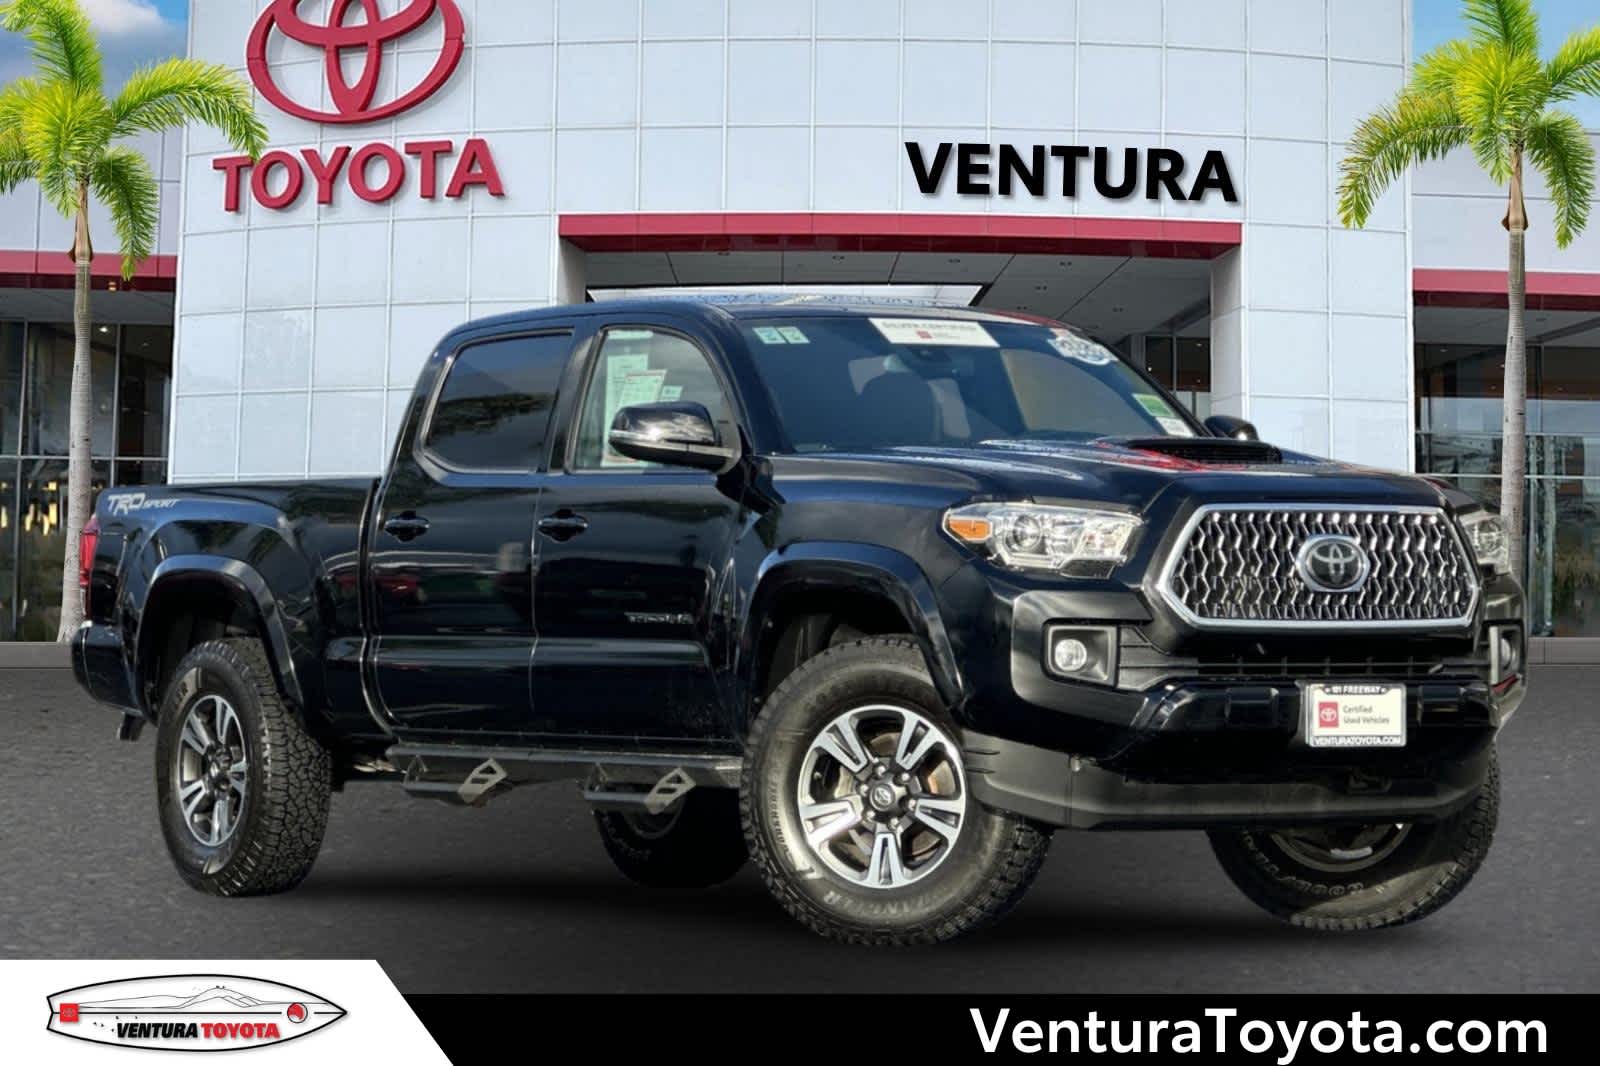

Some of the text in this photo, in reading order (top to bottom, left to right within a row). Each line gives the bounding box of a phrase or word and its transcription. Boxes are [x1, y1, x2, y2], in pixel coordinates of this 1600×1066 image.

[212, 138, 505, 213] TOYOTA
[904, 141, 1238, 202] VENTURA
[107, 492, 146, 517] TRD
[1343, 685, 1381, 693] FREEWAY
[1343, 705, 1373, 714] Certified
